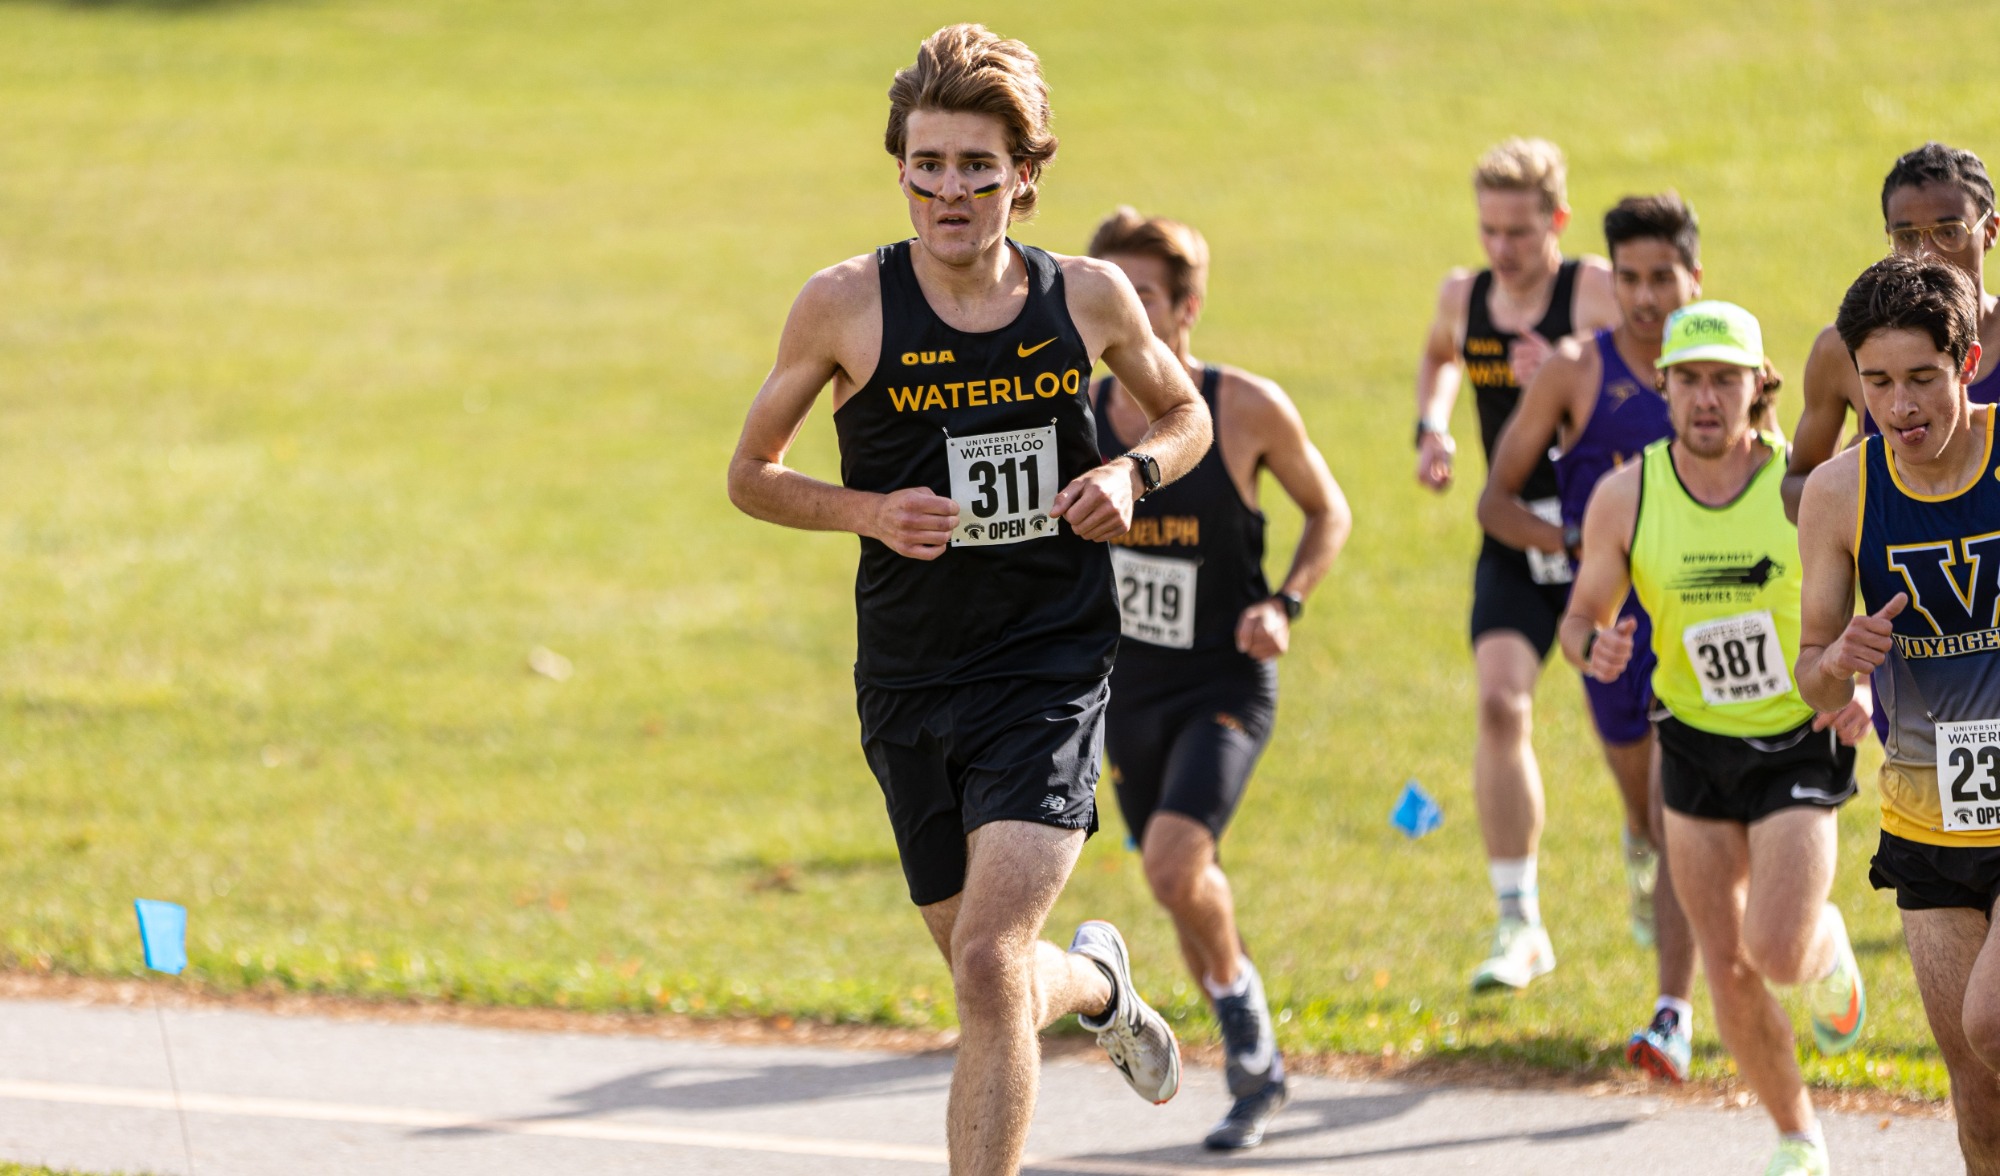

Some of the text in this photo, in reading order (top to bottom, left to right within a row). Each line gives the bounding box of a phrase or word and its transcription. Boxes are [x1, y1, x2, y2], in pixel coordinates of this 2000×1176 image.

[902, 350, 956, 366] OUA
[888, 368, 1080, 412] WATERLOO
[960, 439, 1044, 459] WATERLOO
[966, 434, 1021, 446] UNIVERSITY
[969, 454, 1039, 518] 311
[988, 518, 1026, 540] OPEN
[1122, 575, 1181, 622] 219
[1681, 591, 1731, 604] HUSKIES
[1892, 628, 2000, 659] VOYAGE
[1697, 633, 1767, 682] 387
[1948, 731, 2000, 745] WATER
[1953, 723, 2000, 733] UNIVERSIT
